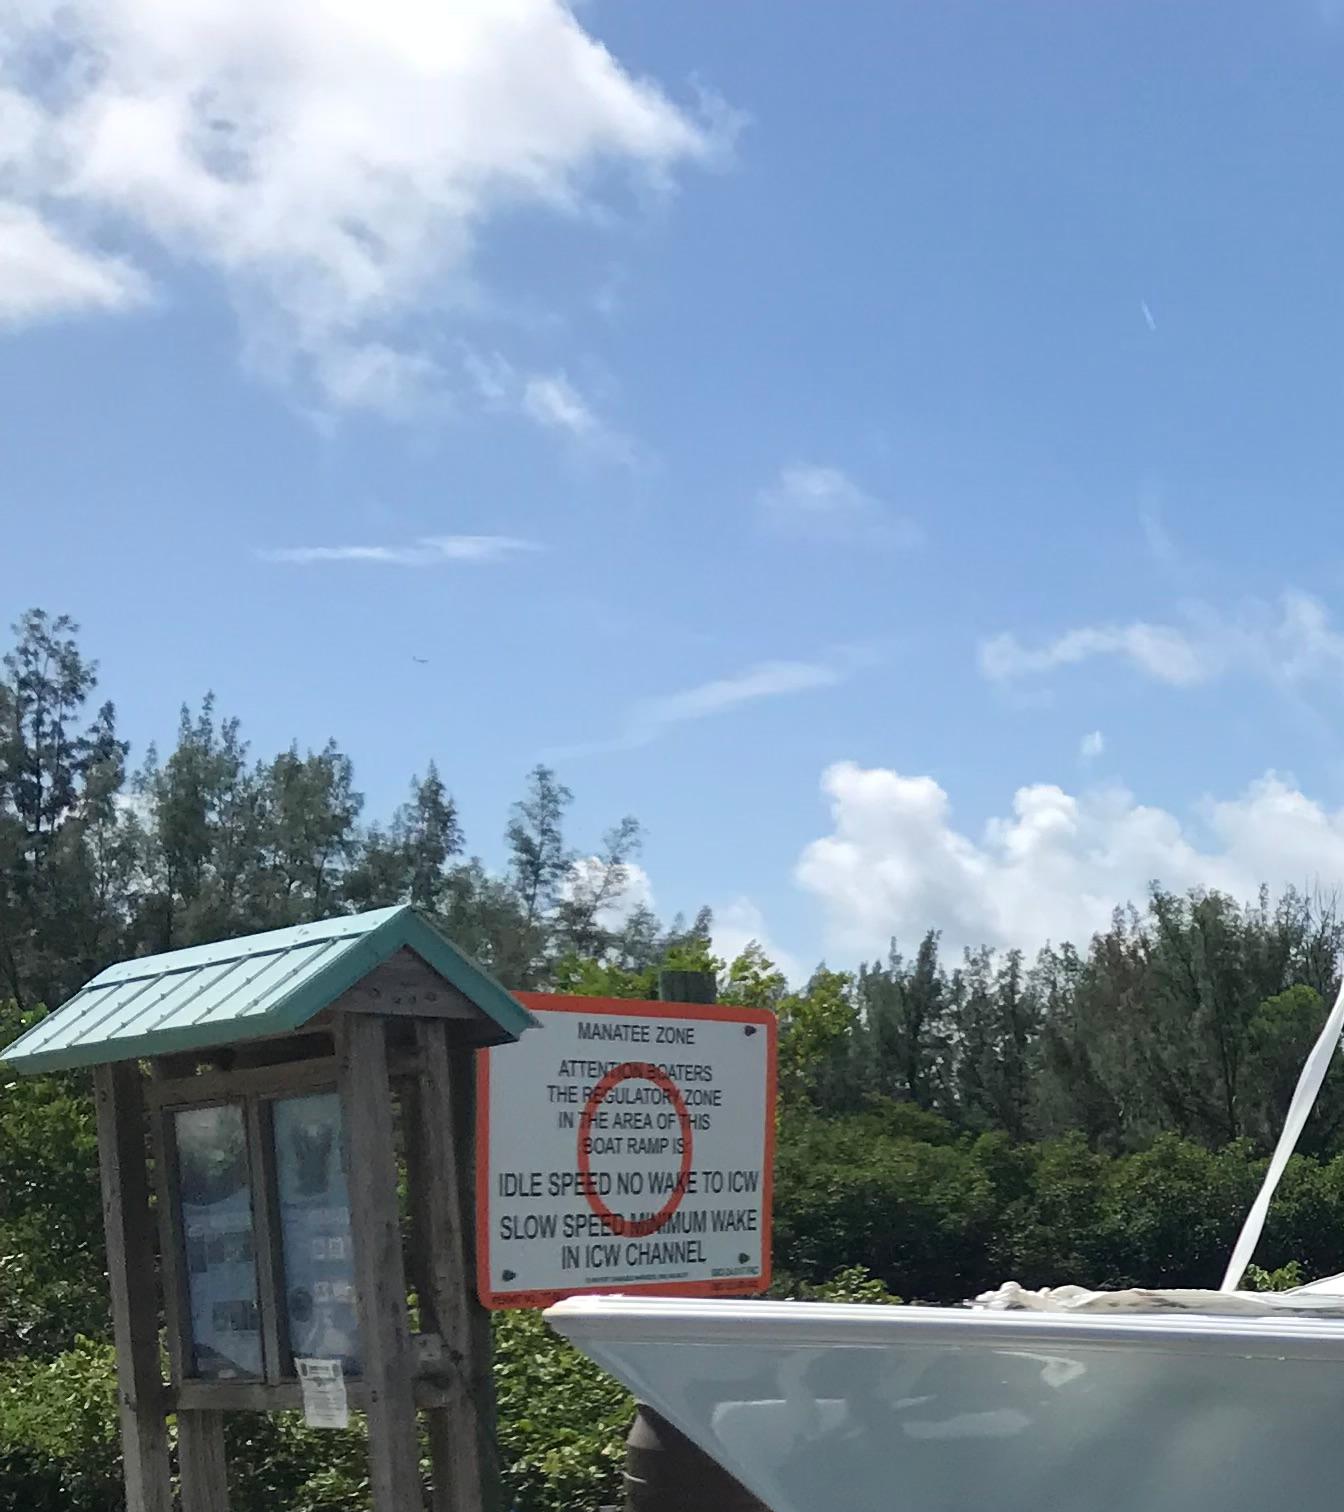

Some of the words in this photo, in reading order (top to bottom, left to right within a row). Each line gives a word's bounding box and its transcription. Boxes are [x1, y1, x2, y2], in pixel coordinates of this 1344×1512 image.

[577, 1022, 650, 1043] MANATEE
[656, 1026, 695, 1044] ZONE
[558, 1060, 643, 1079] ATTENTION
[647, 1063, 712, 1081] BOATERS
[547, 1085, 577, 1103] THE
[582, 1086, 681, 1105] REGULATORY
[684, 1089, 722, 1106] ZONE
[558, 1112, 574, 1129] IN
[578, 1112, 608, 1129] THE
[612, 1112, 652, 1130] AREA
[657, 1112, 676, 1129] OF
[680, 1113, 711, 1130] THIS
[583, 1137, 622, 1154] BOAT
[627, 1137, 669, 1154] RAMP
[672, 1137, 685, 1154] IS
[499, 1172, 542, 1197] IDLE
[548, 1172, 611, 1196] SPEED
[617, 1171, 644, 1195] NO
[648, 1171, 697, 1195] WAKE
[702, 1170, 724, 1194] TO
[728, 1170, 760, 1193] ICW
[500, 1213, 557, 1240] SLOW
[562, 1213, 623, 1238] SPEED
[630, 1211, 707, 1236] MINIMUM
[711, 1209, 757, 1232] WAKE
[562, 1245, 580, 1270] IN
[585, 1243, 622, 1268] ICW
[626, 1240, 707, 1267] CHANNEL
